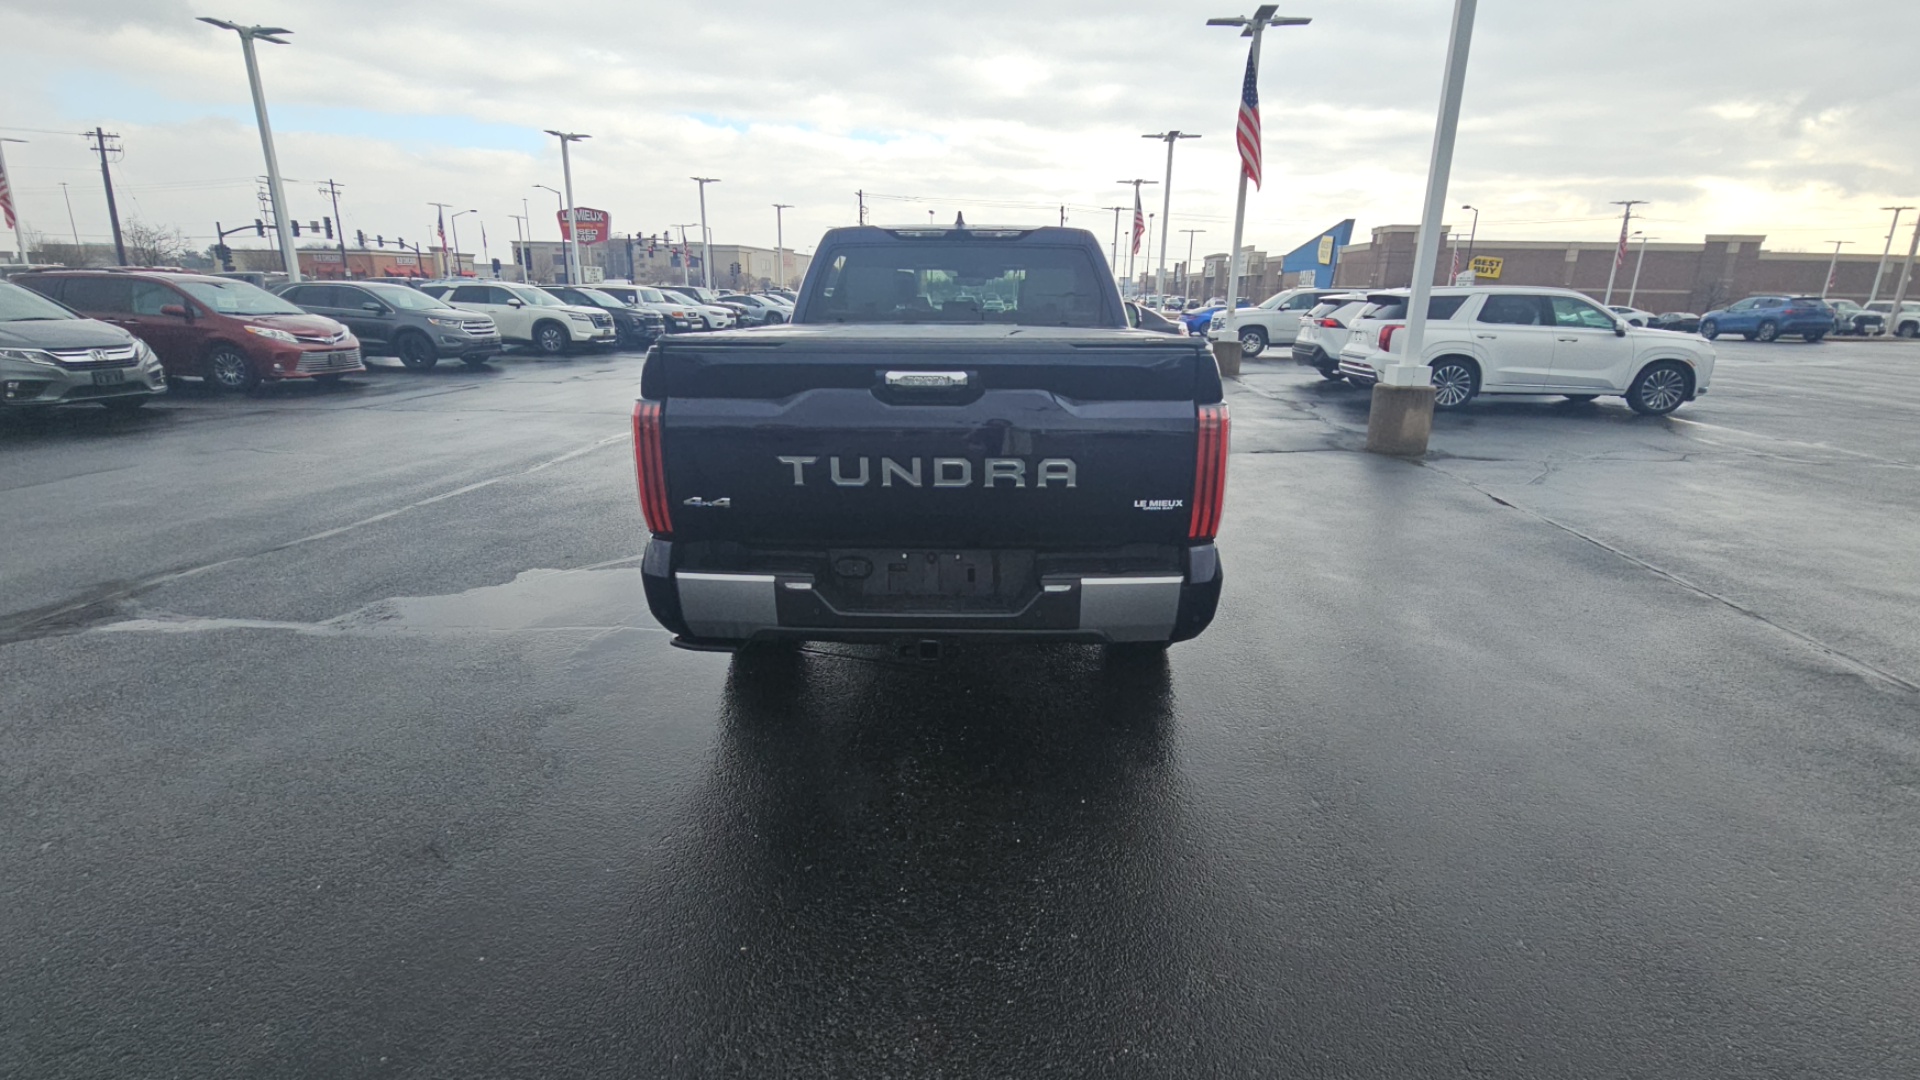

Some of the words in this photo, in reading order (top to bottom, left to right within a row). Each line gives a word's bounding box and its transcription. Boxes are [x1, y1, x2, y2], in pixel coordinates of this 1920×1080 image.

[574, 209, 604, 222] MIEUX
[1474, 258, 1501, 267] BEST
[1474, 265, 1497, 275] BUY
[777, 455, 1077, 488] TUNDRA
[1134, 499, 1147, 507] LE
[1149, 499, 1183, 507] MIEUX
